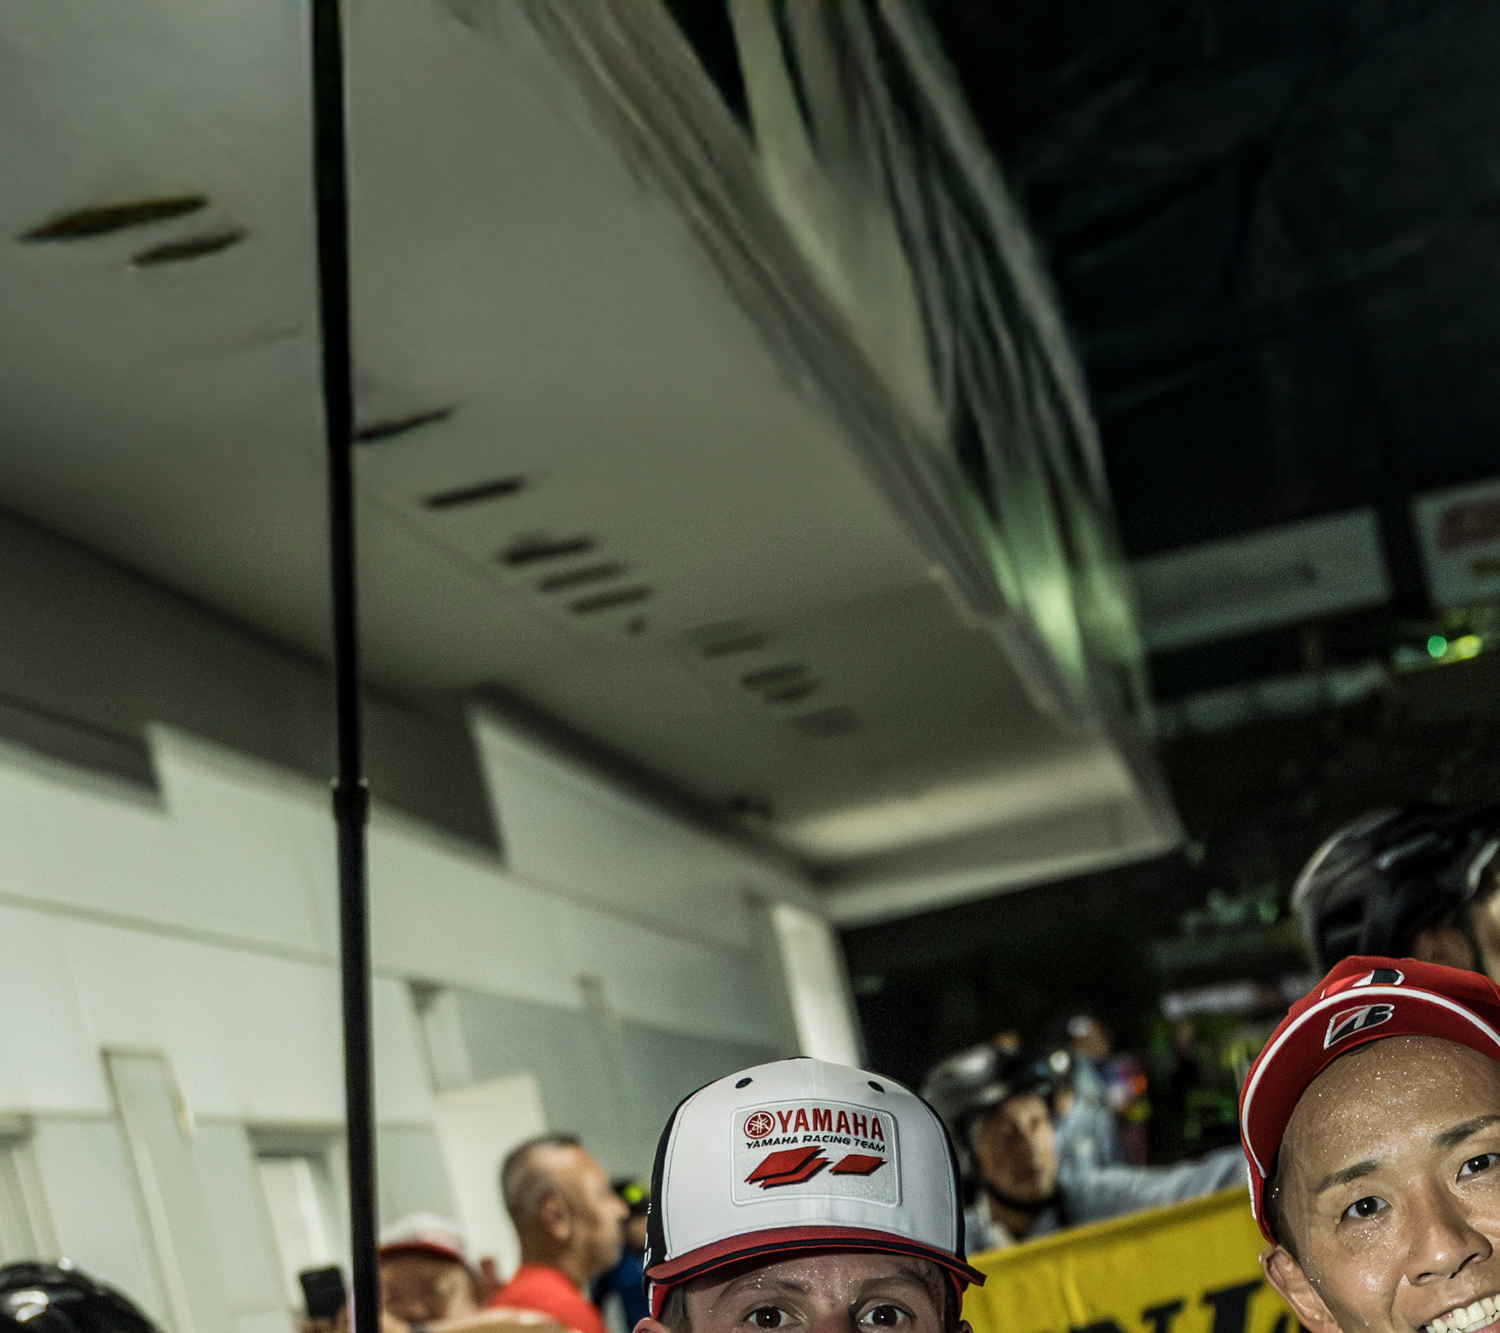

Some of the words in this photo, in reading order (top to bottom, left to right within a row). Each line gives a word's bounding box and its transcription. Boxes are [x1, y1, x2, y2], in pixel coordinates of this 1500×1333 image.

[776, 1108, 884, 1141] YAMAHA
[746, 1136, 798, 1149] YAMAHA
[802, 1135, 850, 1145] RACING
[854, 1138, 885, 1152] TEAM
